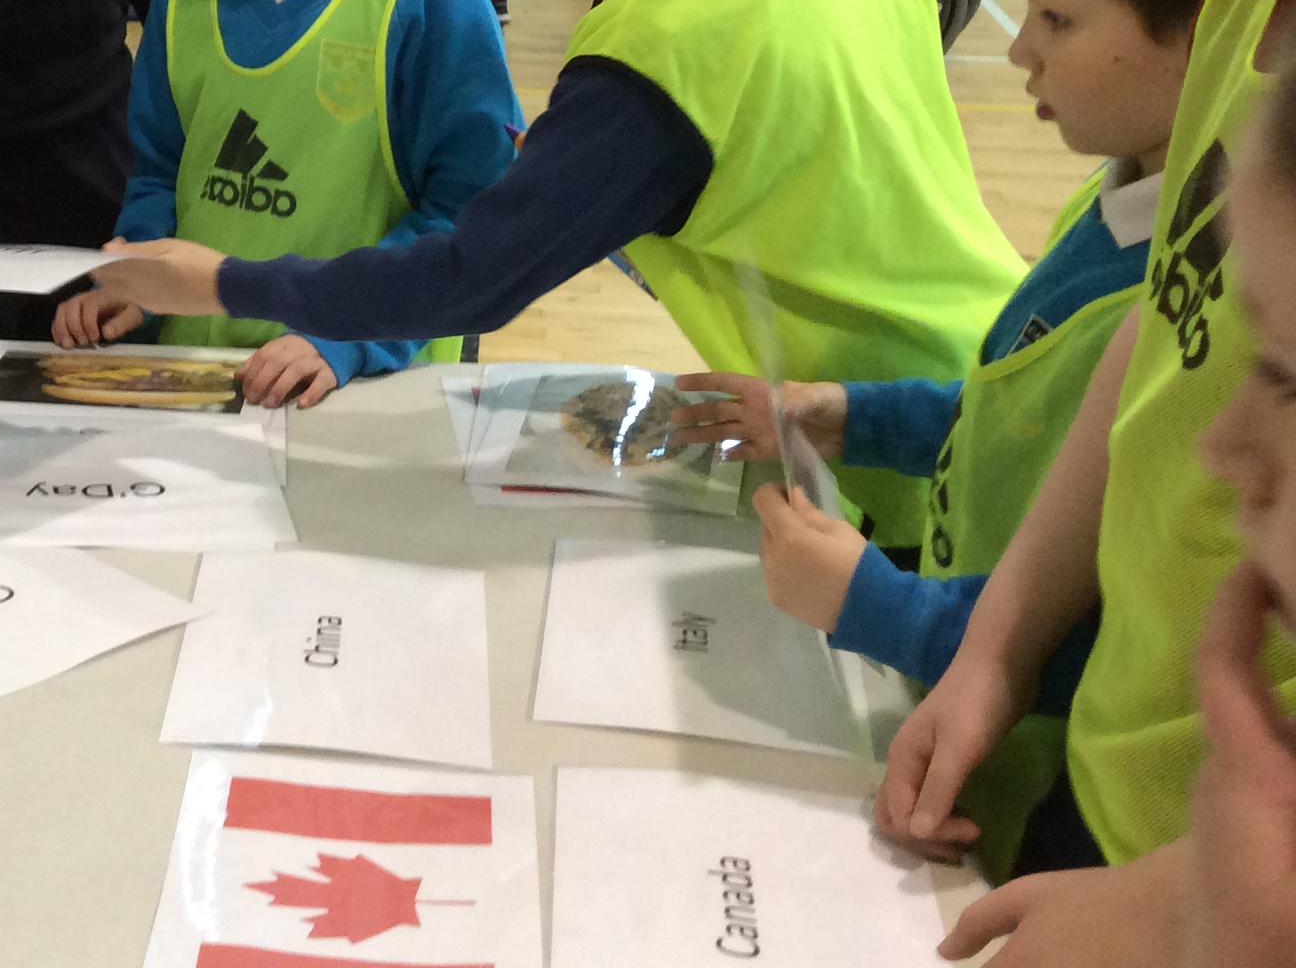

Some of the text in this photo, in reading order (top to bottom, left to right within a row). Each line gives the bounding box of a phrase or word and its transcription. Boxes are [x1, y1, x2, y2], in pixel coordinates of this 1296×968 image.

[24, 480, 166, 500] G'Day
[302, 615, 343, 669] China
[671, 611, 717, 654] Italy
[706, 855, 761, 960] Canada
